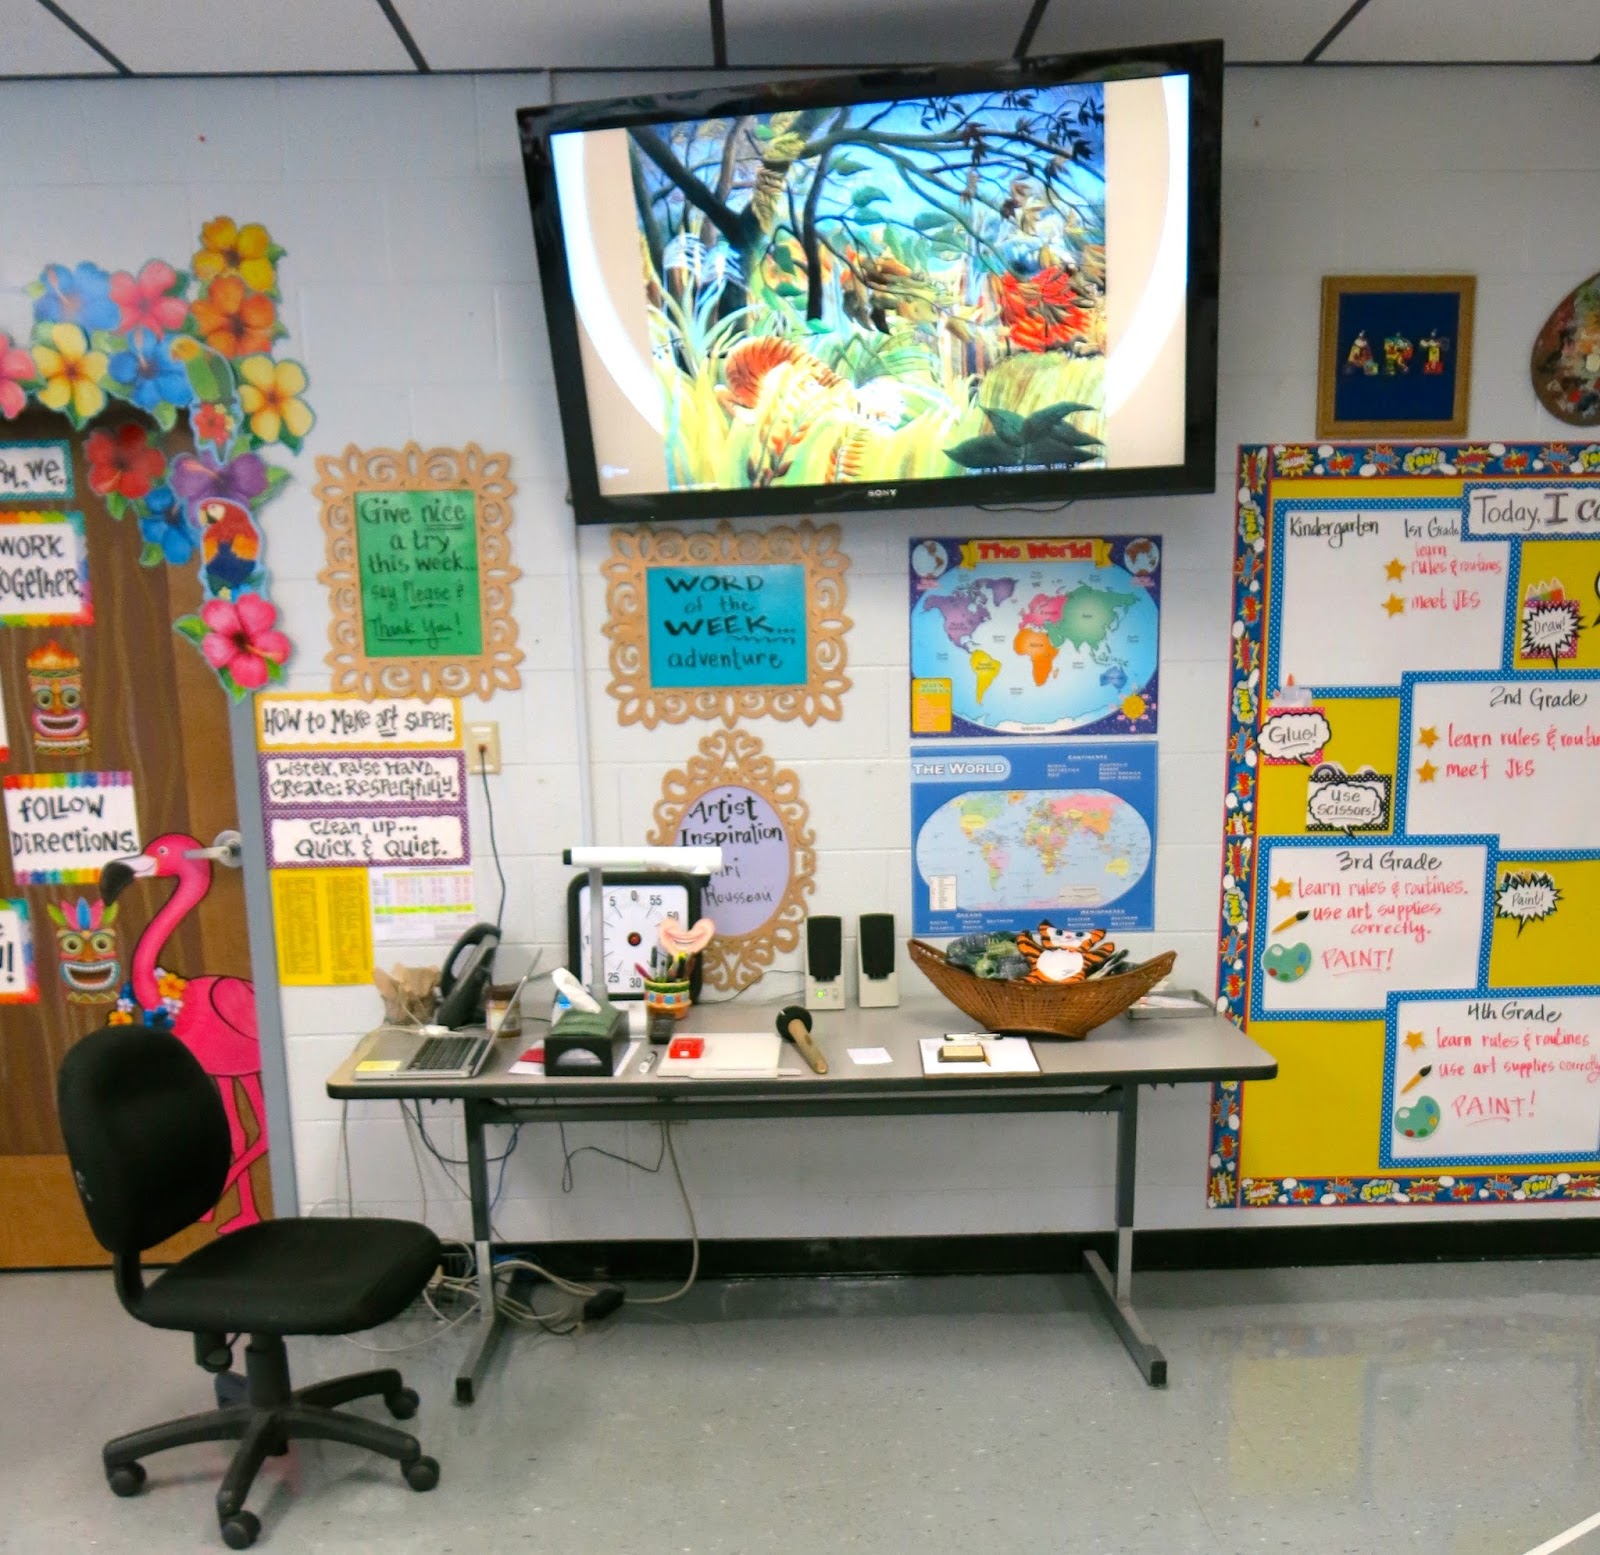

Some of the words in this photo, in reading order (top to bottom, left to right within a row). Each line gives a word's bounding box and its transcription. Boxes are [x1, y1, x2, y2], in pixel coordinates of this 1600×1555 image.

[867, 489, 897, 497] SONY
[360, 498, 412, 524] Give
[421, 498, 465, 523] nice
[1474, 495, 1540, 531] Today,
[1545, 493, 1570, 527] I
[1290, 514, 1379, 548] Kindergarten
[1428, 516, 1459, 538] Grade
[390, 534, 405, 550] a
[413, 530, 450, 553] try
[978, 542, 1021, 559] The
[1027, 542, 1093, 559] World
[1416, 543, 1447, 557] learn
[368, 554, 410, 574] this
[1412, 557, 1447, 575] rules
[665, 574, 764, 593] WORD
[371, 585, 398, 611] say
[403, 580, 451, 602] Please
[684, 596, 704, 614] of
[720, 595, 756, 612] the
[1412, 586, 1447, 609] meet
[1454, 590, 1481, 611] JES
[368, 613, 415, 637] Thank
[1534, 615, 1566, 634] Draw!
[668, 647, 783, 670] adventure
[1490, 686, 1521, 708] 2nd
[1530, 687, 1588, 711] Grade
[306, 711, 325, 733] to
[1268, 723, 1318, 744] Glue!
[1447, 722, 1492, 748] learn
[1501, 726, 1540, 746] rules
[913, 763, 945, 775] THE
[949, 762, 1005, 775] WORLD
[1446, 758, 1488, 780] meet
[1505, 757, 1535, 779] JES
[688, 793, 758, 824] Artist
[681, 822, 784, 848] Inspiration
[1336, 850, 1373, 871] 3rd
[1380, 850, 1442, 871] Grade
[630, 890, 638, 902] 0
[702, 884, 772, 907] Rousseau
[1298, 877, 1341, 899] learn
[1349, 877, 1386, 898] rules
[1511, 889, 1544, 907] Paint!
[609, 895, 617, 907] 5
[649, 895, 663, 906] 55
[1313, 905, 1340, 921] use
[1347, 900, 1372, 920] art
[1378, 900, 1441, 922] supplies
[1350, 919, 1432, 944] correctly.
[1322, 948, 1394, 971] PAINT!
[607, 972, 620, 983] 25
[629, 977, 642, 988] 30
[1467, 1002, 1497, 1020] 4th
[1502, 1001, 1562, 1023] Grade
[1436, 1027, 1472, 1049] learn
[1482, 1031, 1519, 1048] rules
[1439, 1062, 1464, 1079] use
[1473, 1056, 1496, 1075] art
[1504, 1057, 1554, 1078] supplies
[1451, 1089, 1536, 1118] PAINT!
[1364, 1183, 1393, 1199] POW!
[1524, 1177, 1552, 1195] POW!
